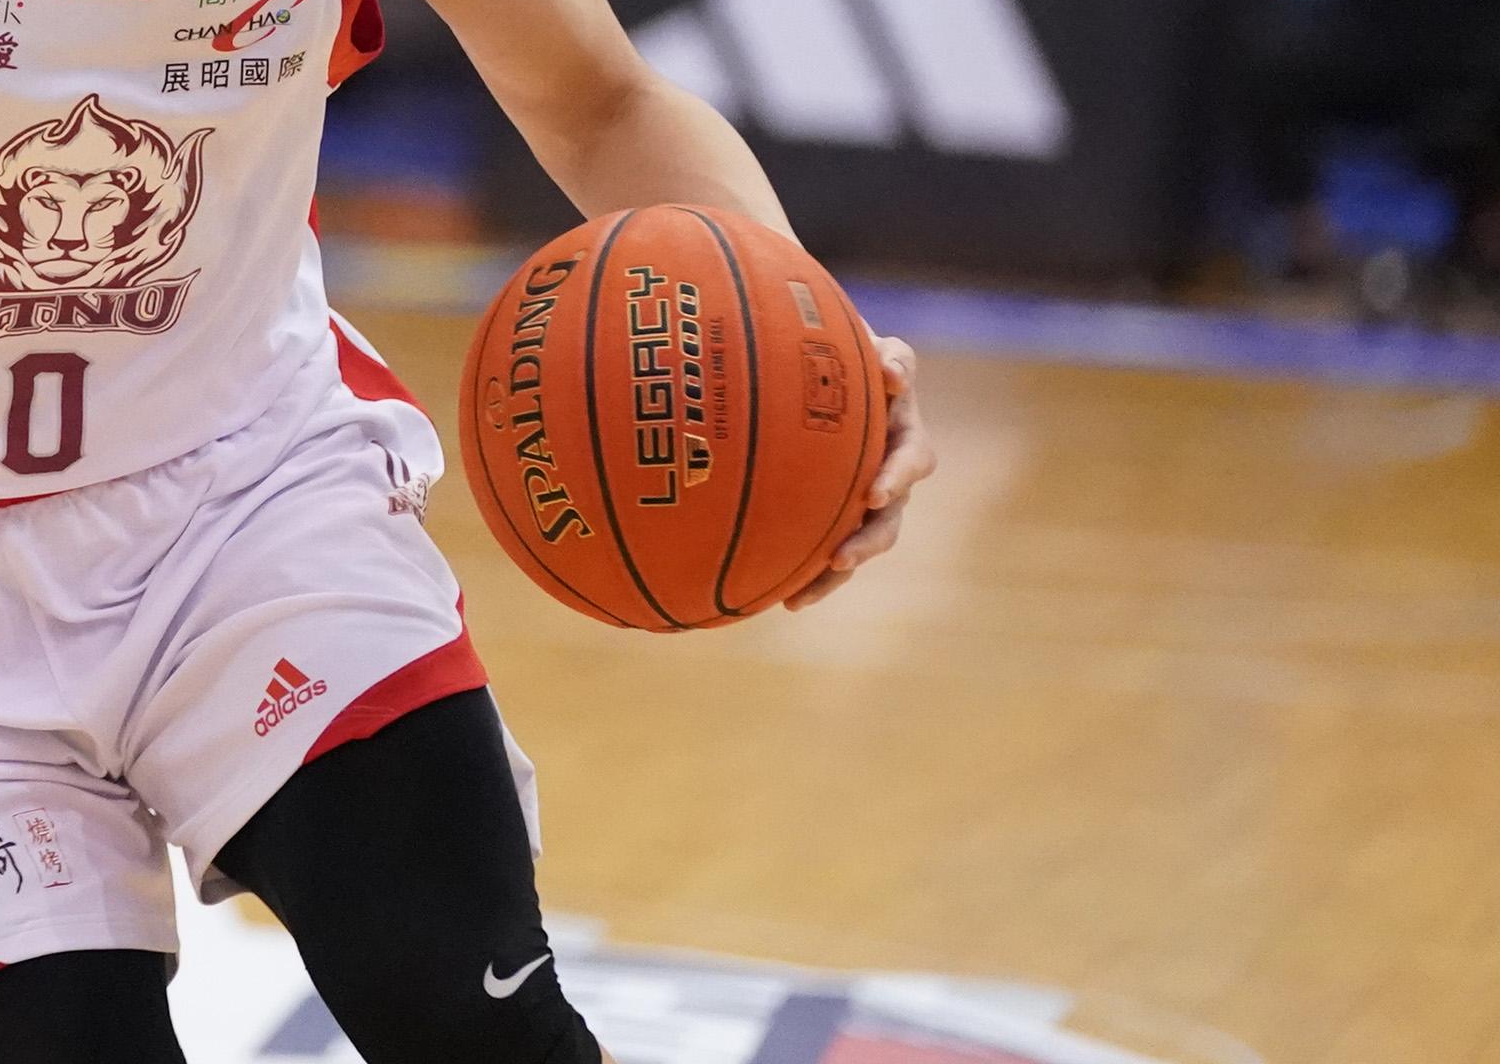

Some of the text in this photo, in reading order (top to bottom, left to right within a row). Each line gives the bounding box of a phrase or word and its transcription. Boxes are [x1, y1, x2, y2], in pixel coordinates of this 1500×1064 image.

[161, 51, 306, 94] 展昭國際
[626, 266, 679, 507] LEGACY
[711, 348, 726, 381] GAME
[1, 352, 89, 474] 0
[509, 256, 595, 545] SPALDING
[712, 385, 728, 440] OFFICIAL
[254, 679, 327, 737] adidas
